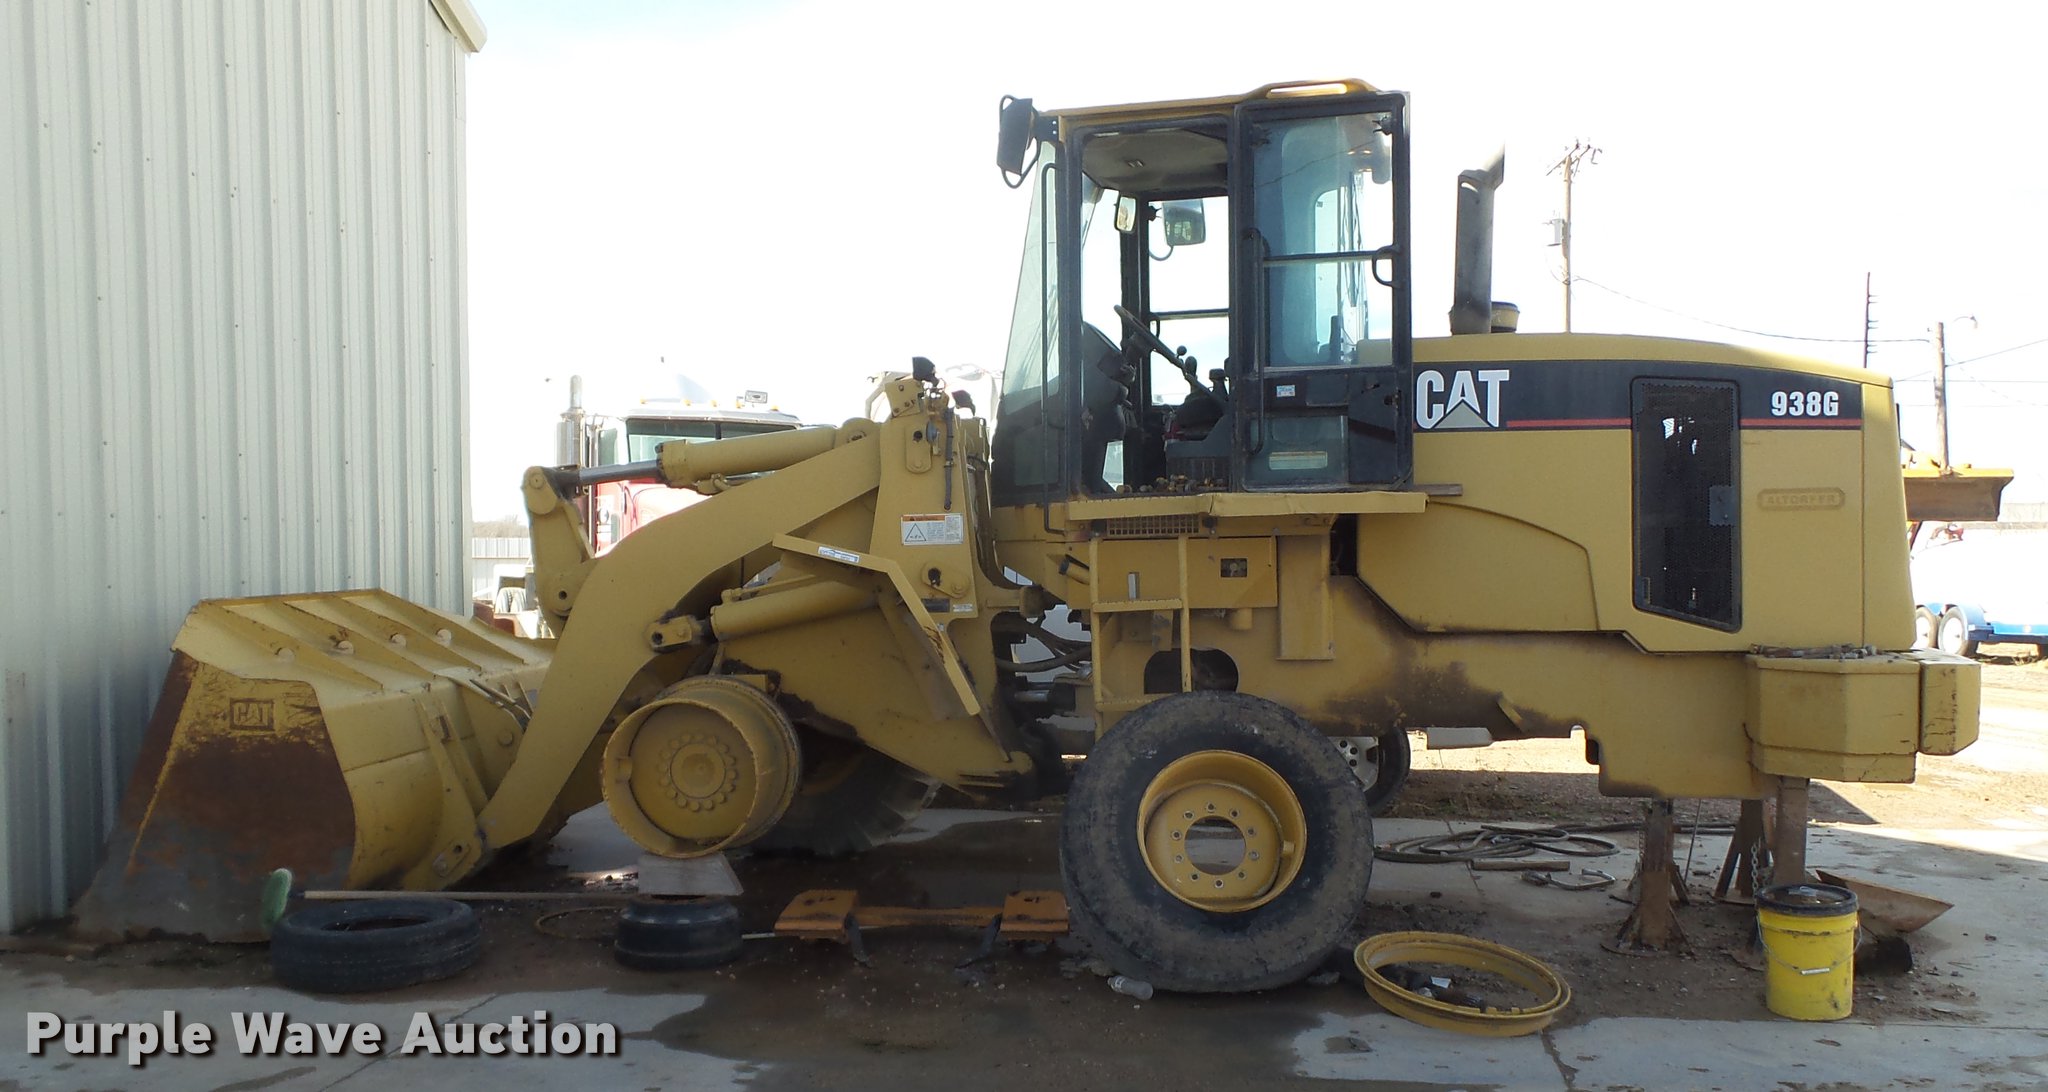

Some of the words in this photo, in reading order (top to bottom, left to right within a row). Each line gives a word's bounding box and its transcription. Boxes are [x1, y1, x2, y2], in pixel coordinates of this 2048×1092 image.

[1416, 369, 1510, 429] CAT
[1771, 391, 1839, 416] 938G
[232, 701, 271, 727] CAT
